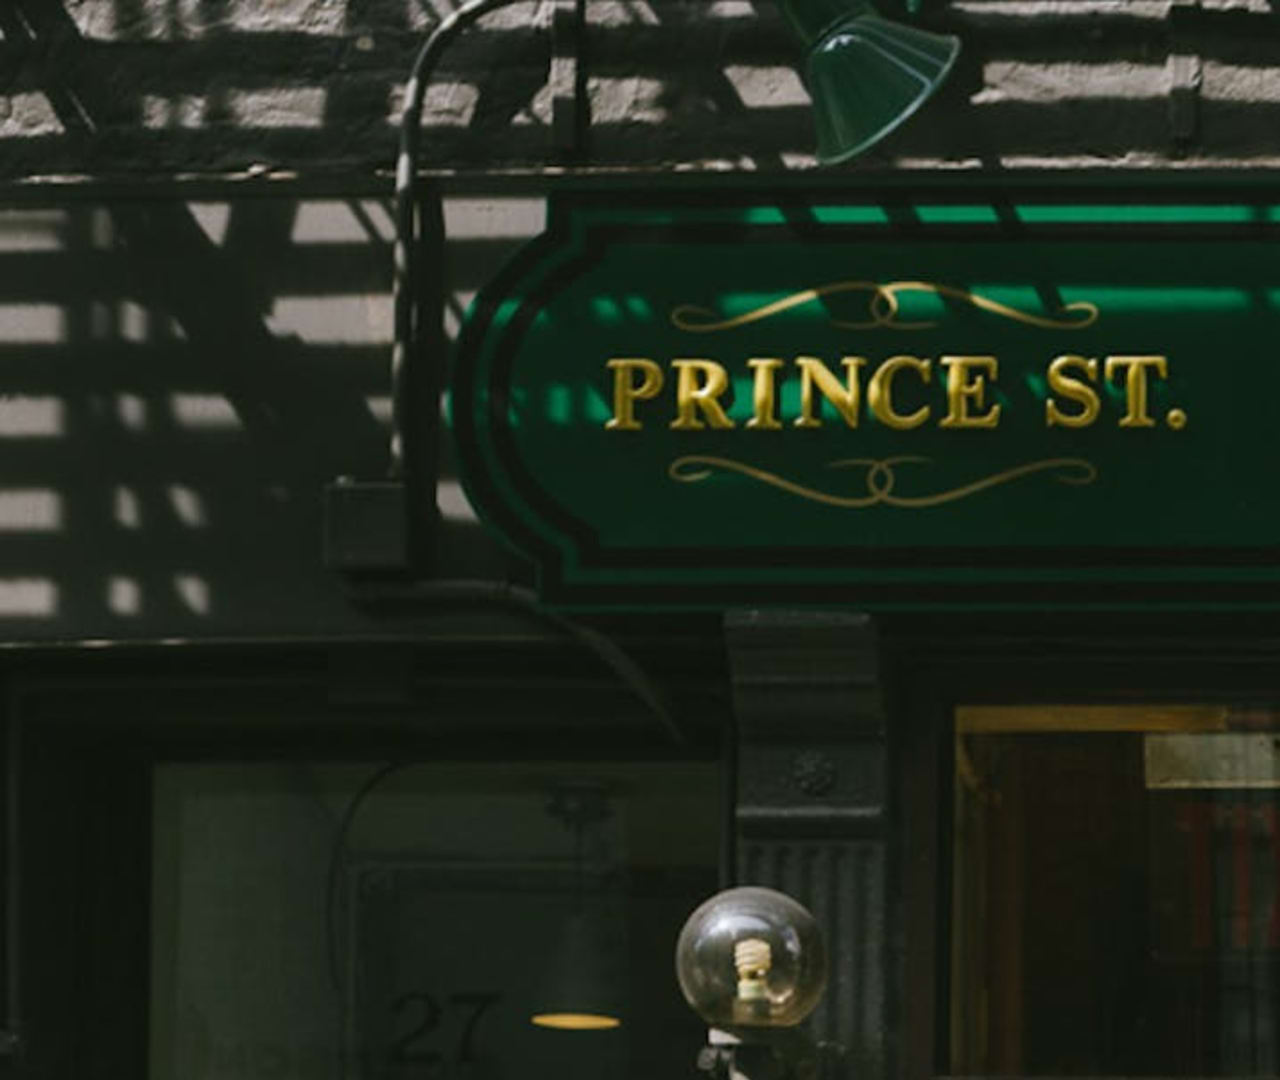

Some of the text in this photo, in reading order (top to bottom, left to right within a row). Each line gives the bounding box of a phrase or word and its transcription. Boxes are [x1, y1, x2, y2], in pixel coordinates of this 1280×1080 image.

[605, 354, 1186, 430] PRINCE ST.
[391, 990, 503, 1062] 27
